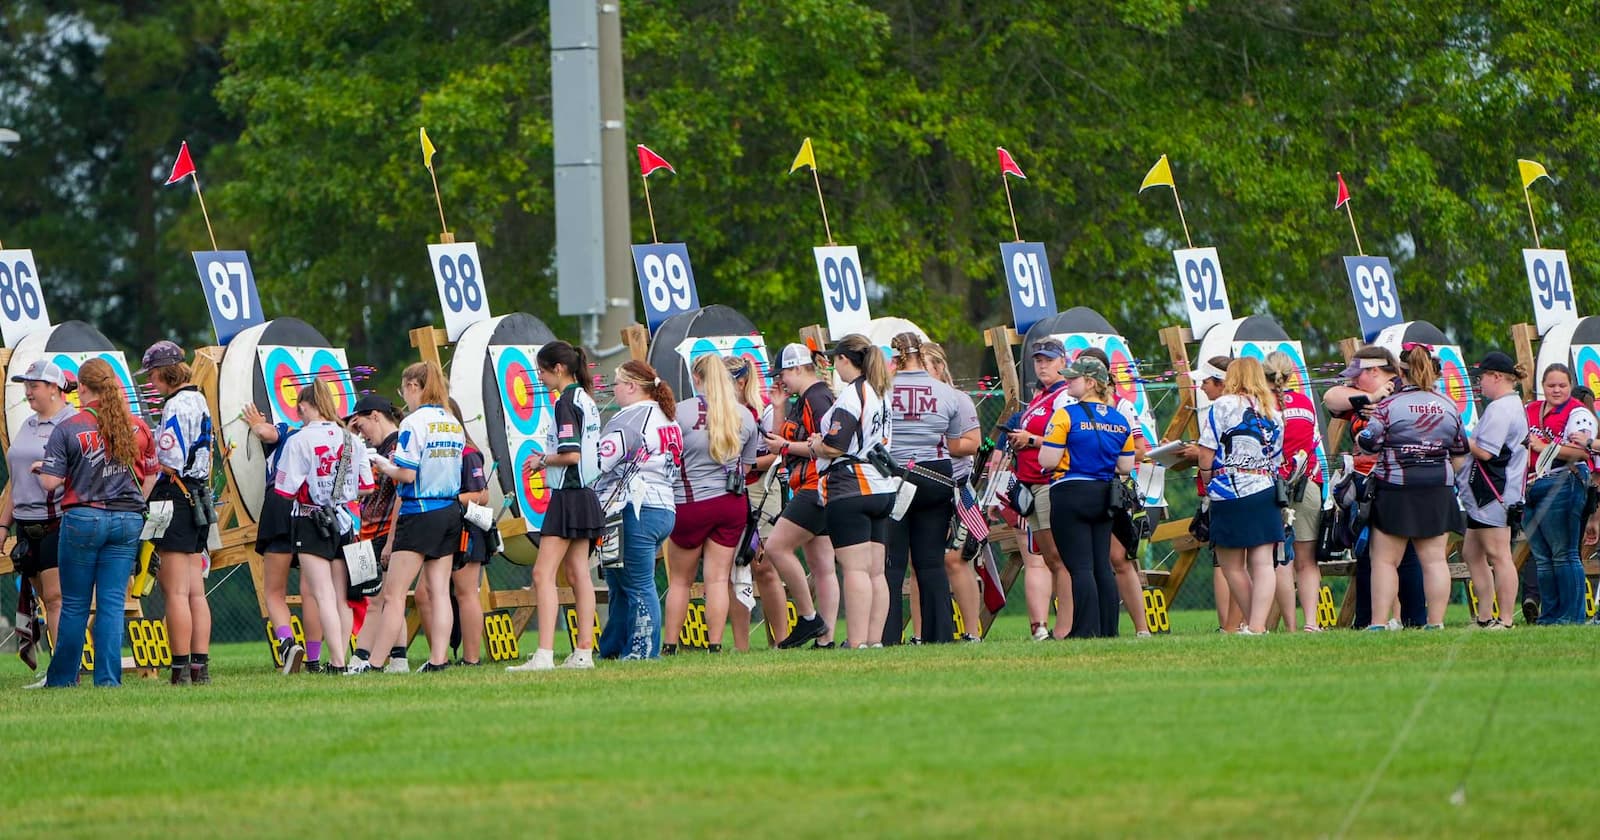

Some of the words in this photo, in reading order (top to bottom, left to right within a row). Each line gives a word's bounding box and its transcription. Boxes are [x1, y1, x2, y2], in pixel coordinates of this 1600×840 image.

[0, 260, 40, 322] 86
[207, 261, 250, 320] 87
[438, 253, 482, 313] 88
[643, 253, 692, 313] 89
[824, 256, 861, 313] 90
[1012, 252, 1047, 309] 91
[1185, 257, 1225, 312] 92
[1355, 265, 1397, 319] 93
[1533, 258, 1572, 310] 94
[1408, 404, 1444, 415] TIGERS
[102, 463, 128, 478] ARCHE
